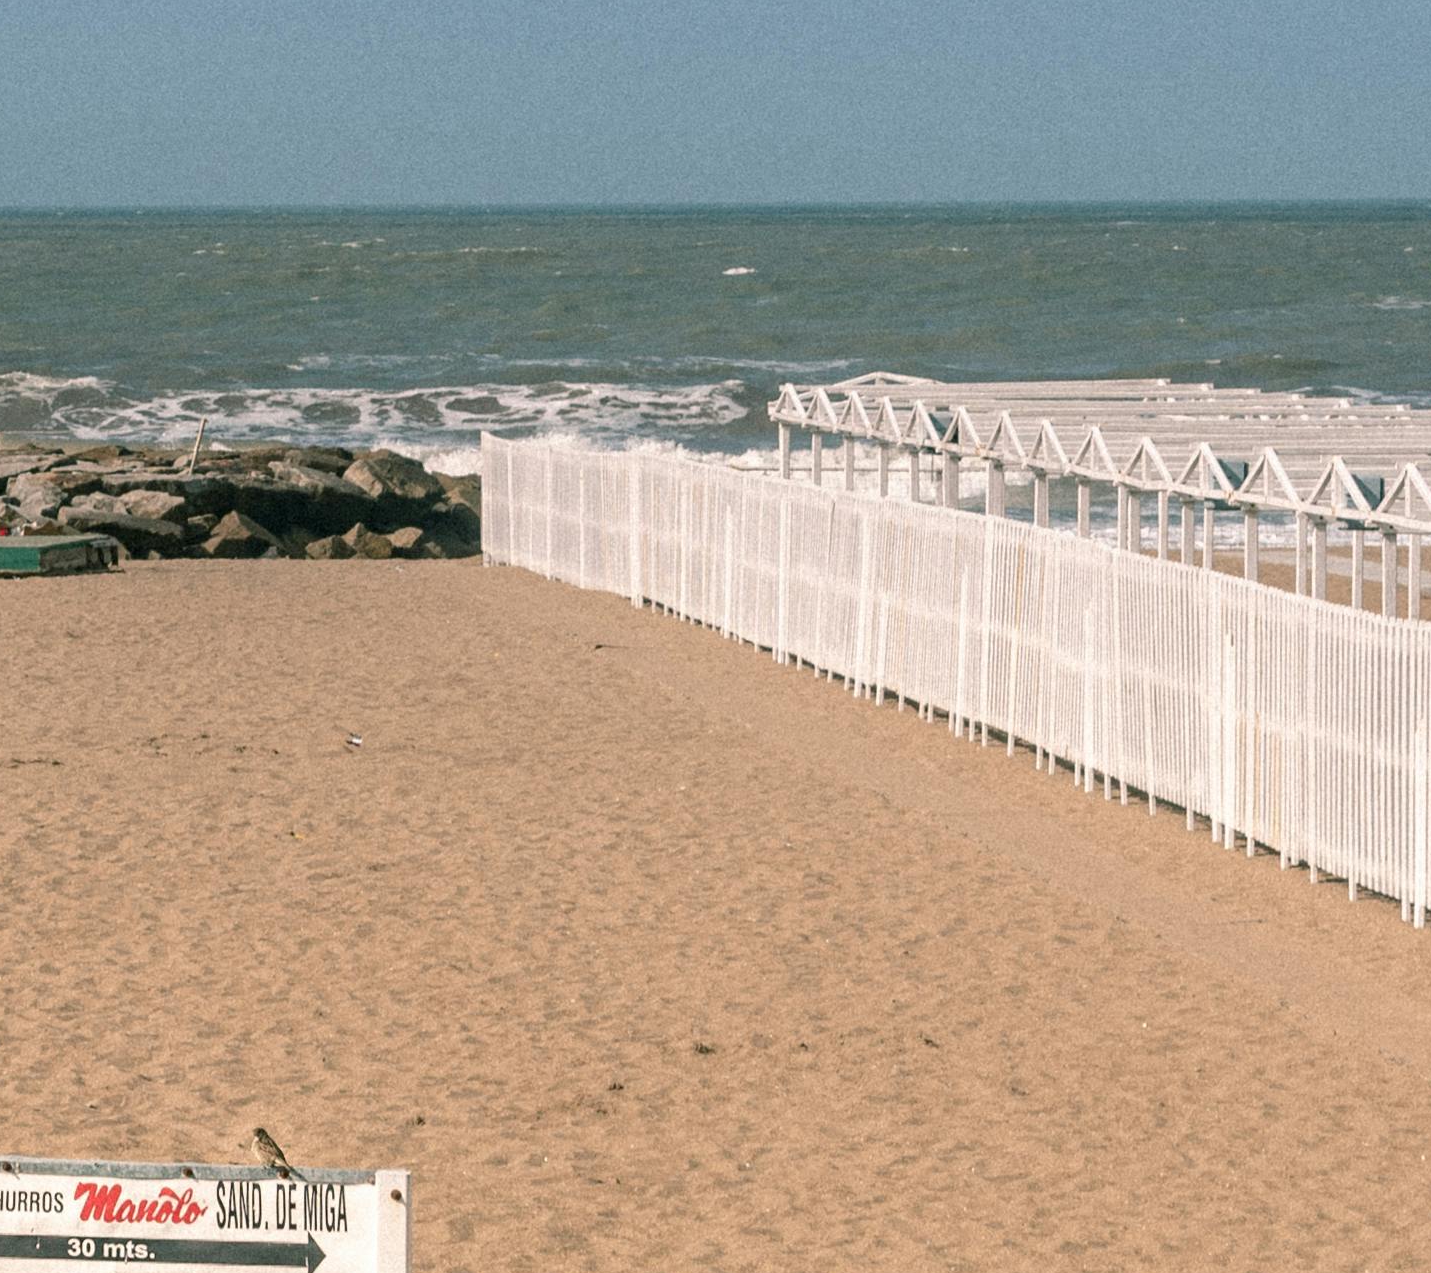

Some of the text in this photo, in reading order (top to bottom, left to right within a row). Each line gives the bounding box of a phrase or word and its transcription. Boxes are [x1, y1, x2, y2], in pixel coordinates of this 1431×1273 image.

[74, 1182, 208, 1225] Manolo
[216, 1180, 269, 1231] SAND.
[276, 1183, 298, 1231] DE
[303, 1182, 349, 1233] MIGA
[67, 1238, 156, 1259] 30 mts.
